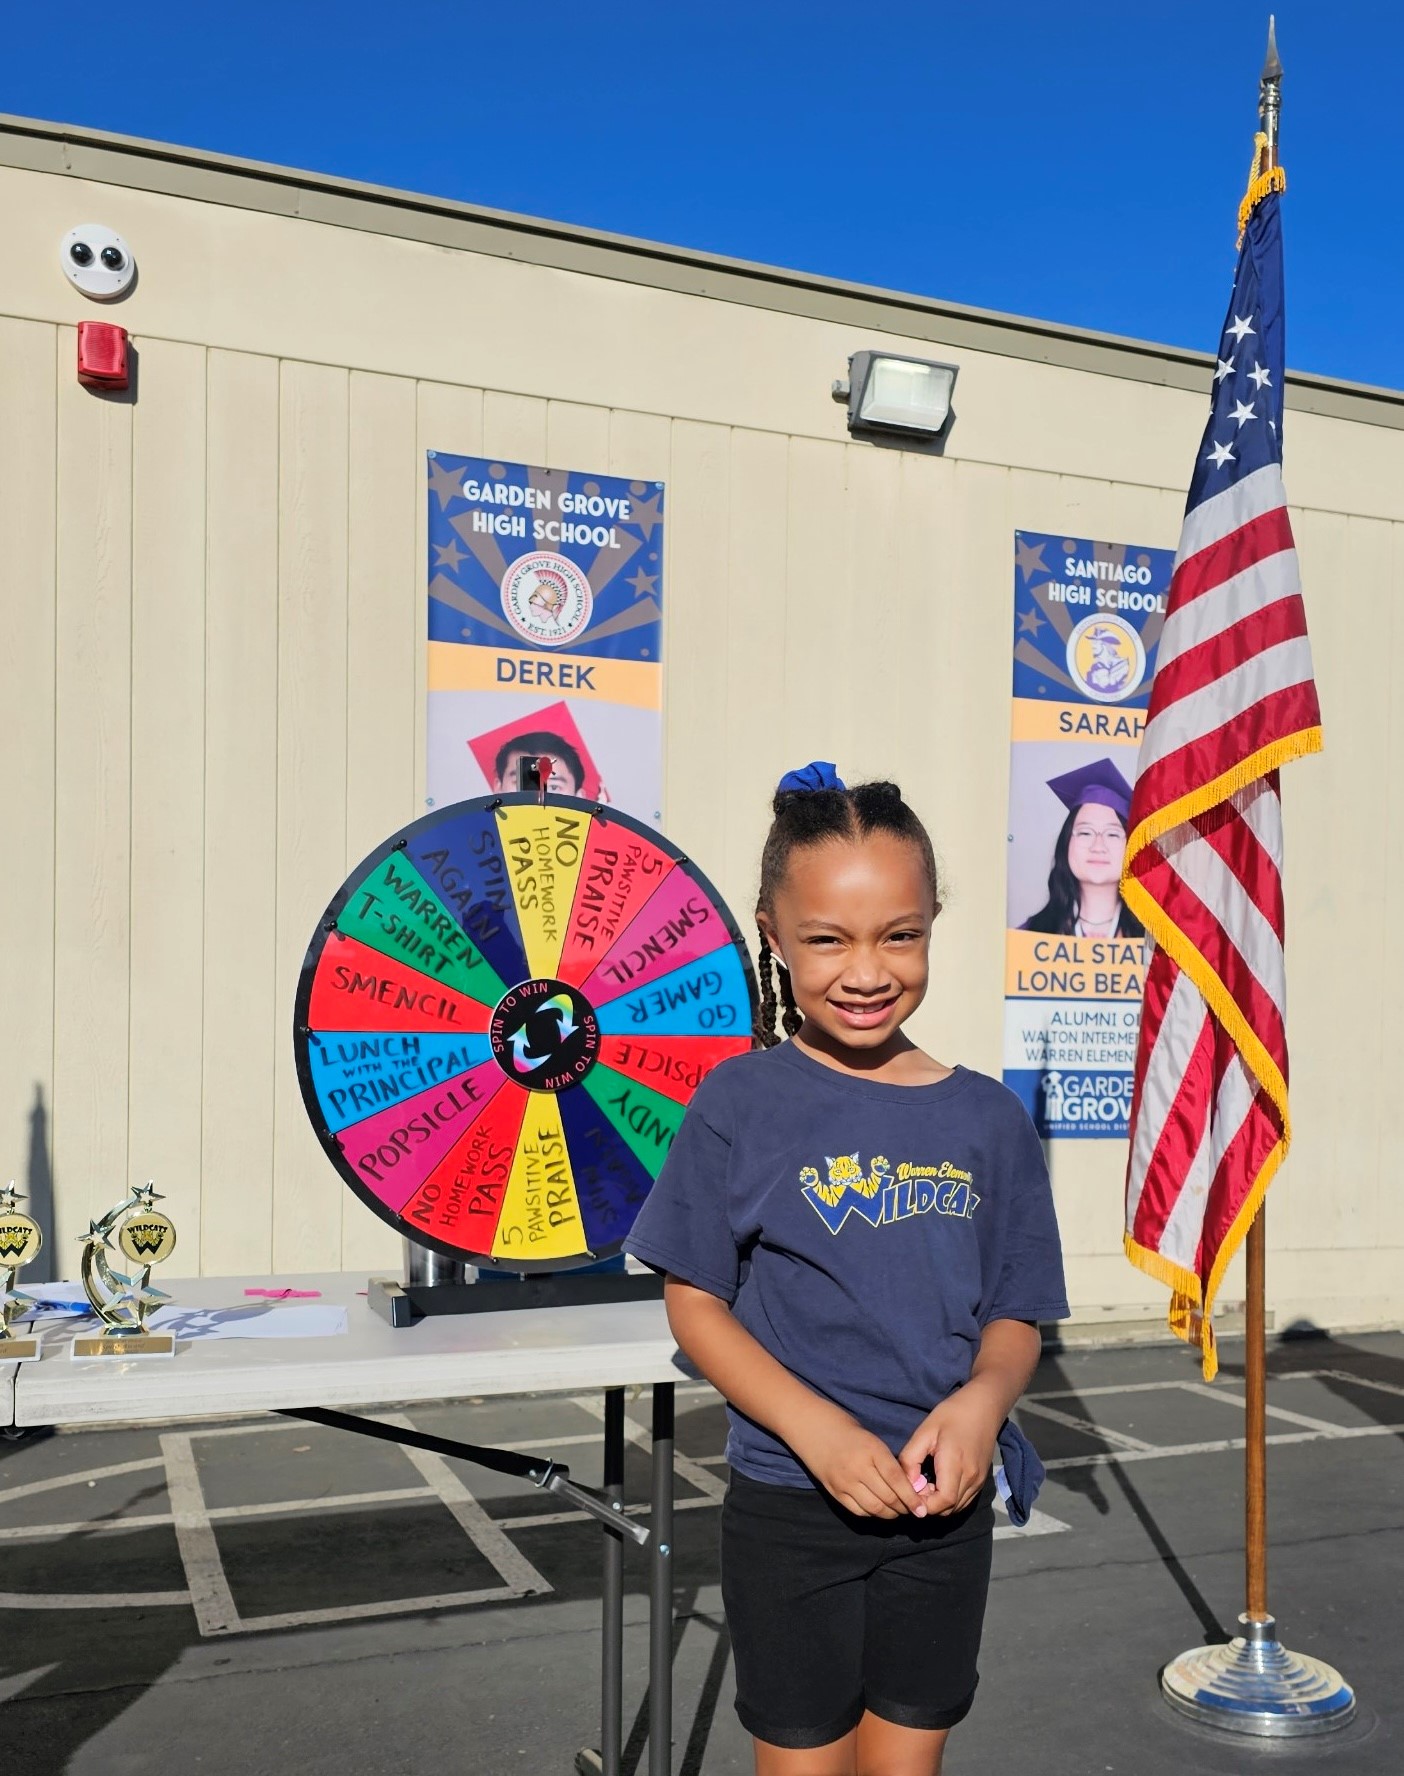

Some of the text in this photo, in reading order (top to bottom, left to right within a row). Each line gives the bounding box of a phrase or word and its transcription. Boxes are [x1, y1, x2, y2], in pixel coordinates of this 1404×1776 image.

[463, 480, 630, 520] GARDEN GROVE
[473, 511, 620, 548] HIGH SCHOOL
[511, 560, 584, 621] GARDEN GROVE HIGH SCHOOL
[1066, 557, 1151, 585] SANTIAGO
[1048, 582, 1166, 614] HIGH SCHOOL
[497, 658, 596, 690] DEREK
[555, 816, 580, 868] NO
[642, 853, 664, 876] 5
[420, 848, 500, 941] AGAIN
[468, 830, 512, 912] SPIN
[509, 836, 539, 910] PASS
[532, 827, 558, 943] HOMEWORK
[600, 844, 642, 942] PAWSITIVE
[383, 864, 484, 970] WARREN
[572, 848, 618, 952] PRAISE
[358, 891, 454, 974] T-SHIRT
[601, 897, 709, 984] SMENCIL
[1034, 942, 1084, 964] CAL
[330, 966, 462, 1025] SMENCIL
[625, 971, 722, 1024] GAMER
[1018, 970, 1142, 994] LONG BEA
[492, 982, 548, 1053] SPIN TO WIN
[698, 1004, 736, 1029] GO
[1022, 1030, 1078, 1044] WALTON
[1051, 1011, 1116, 1026] ALUMNI
[320, 1036, 420, 1066] LUNCH
[343, 1056, 420, 1078] WITH THE
[546, 1015, 596, 1088] SPIN TO WIN
[614, 1041, 712, 1088] PSICLE
[1026, 1048, 1082, 1062] WARREN
[328, 1046, 479, 1119] PRINCIPAL
[1064, 1076, 1135, 1096] GARDE
[358, 1077, 486, 1182] POPSICLE
[608, 1088, 674, 1149] NDY
[439, 1124, 493, 1227] HOMEWORK
[468, 1142, 514, 1216] PASS
[524, 1141, 547, 1242] PAWSITIVE
[538, 1124, 576, 1228] PRAISE
[896, 1162, 938, 1180] Warren
[127, 1224, 168, 1234] WILDCATS
[412, 1184, 442, 1224] NO
[502, 1226, 524, 1245] 5
